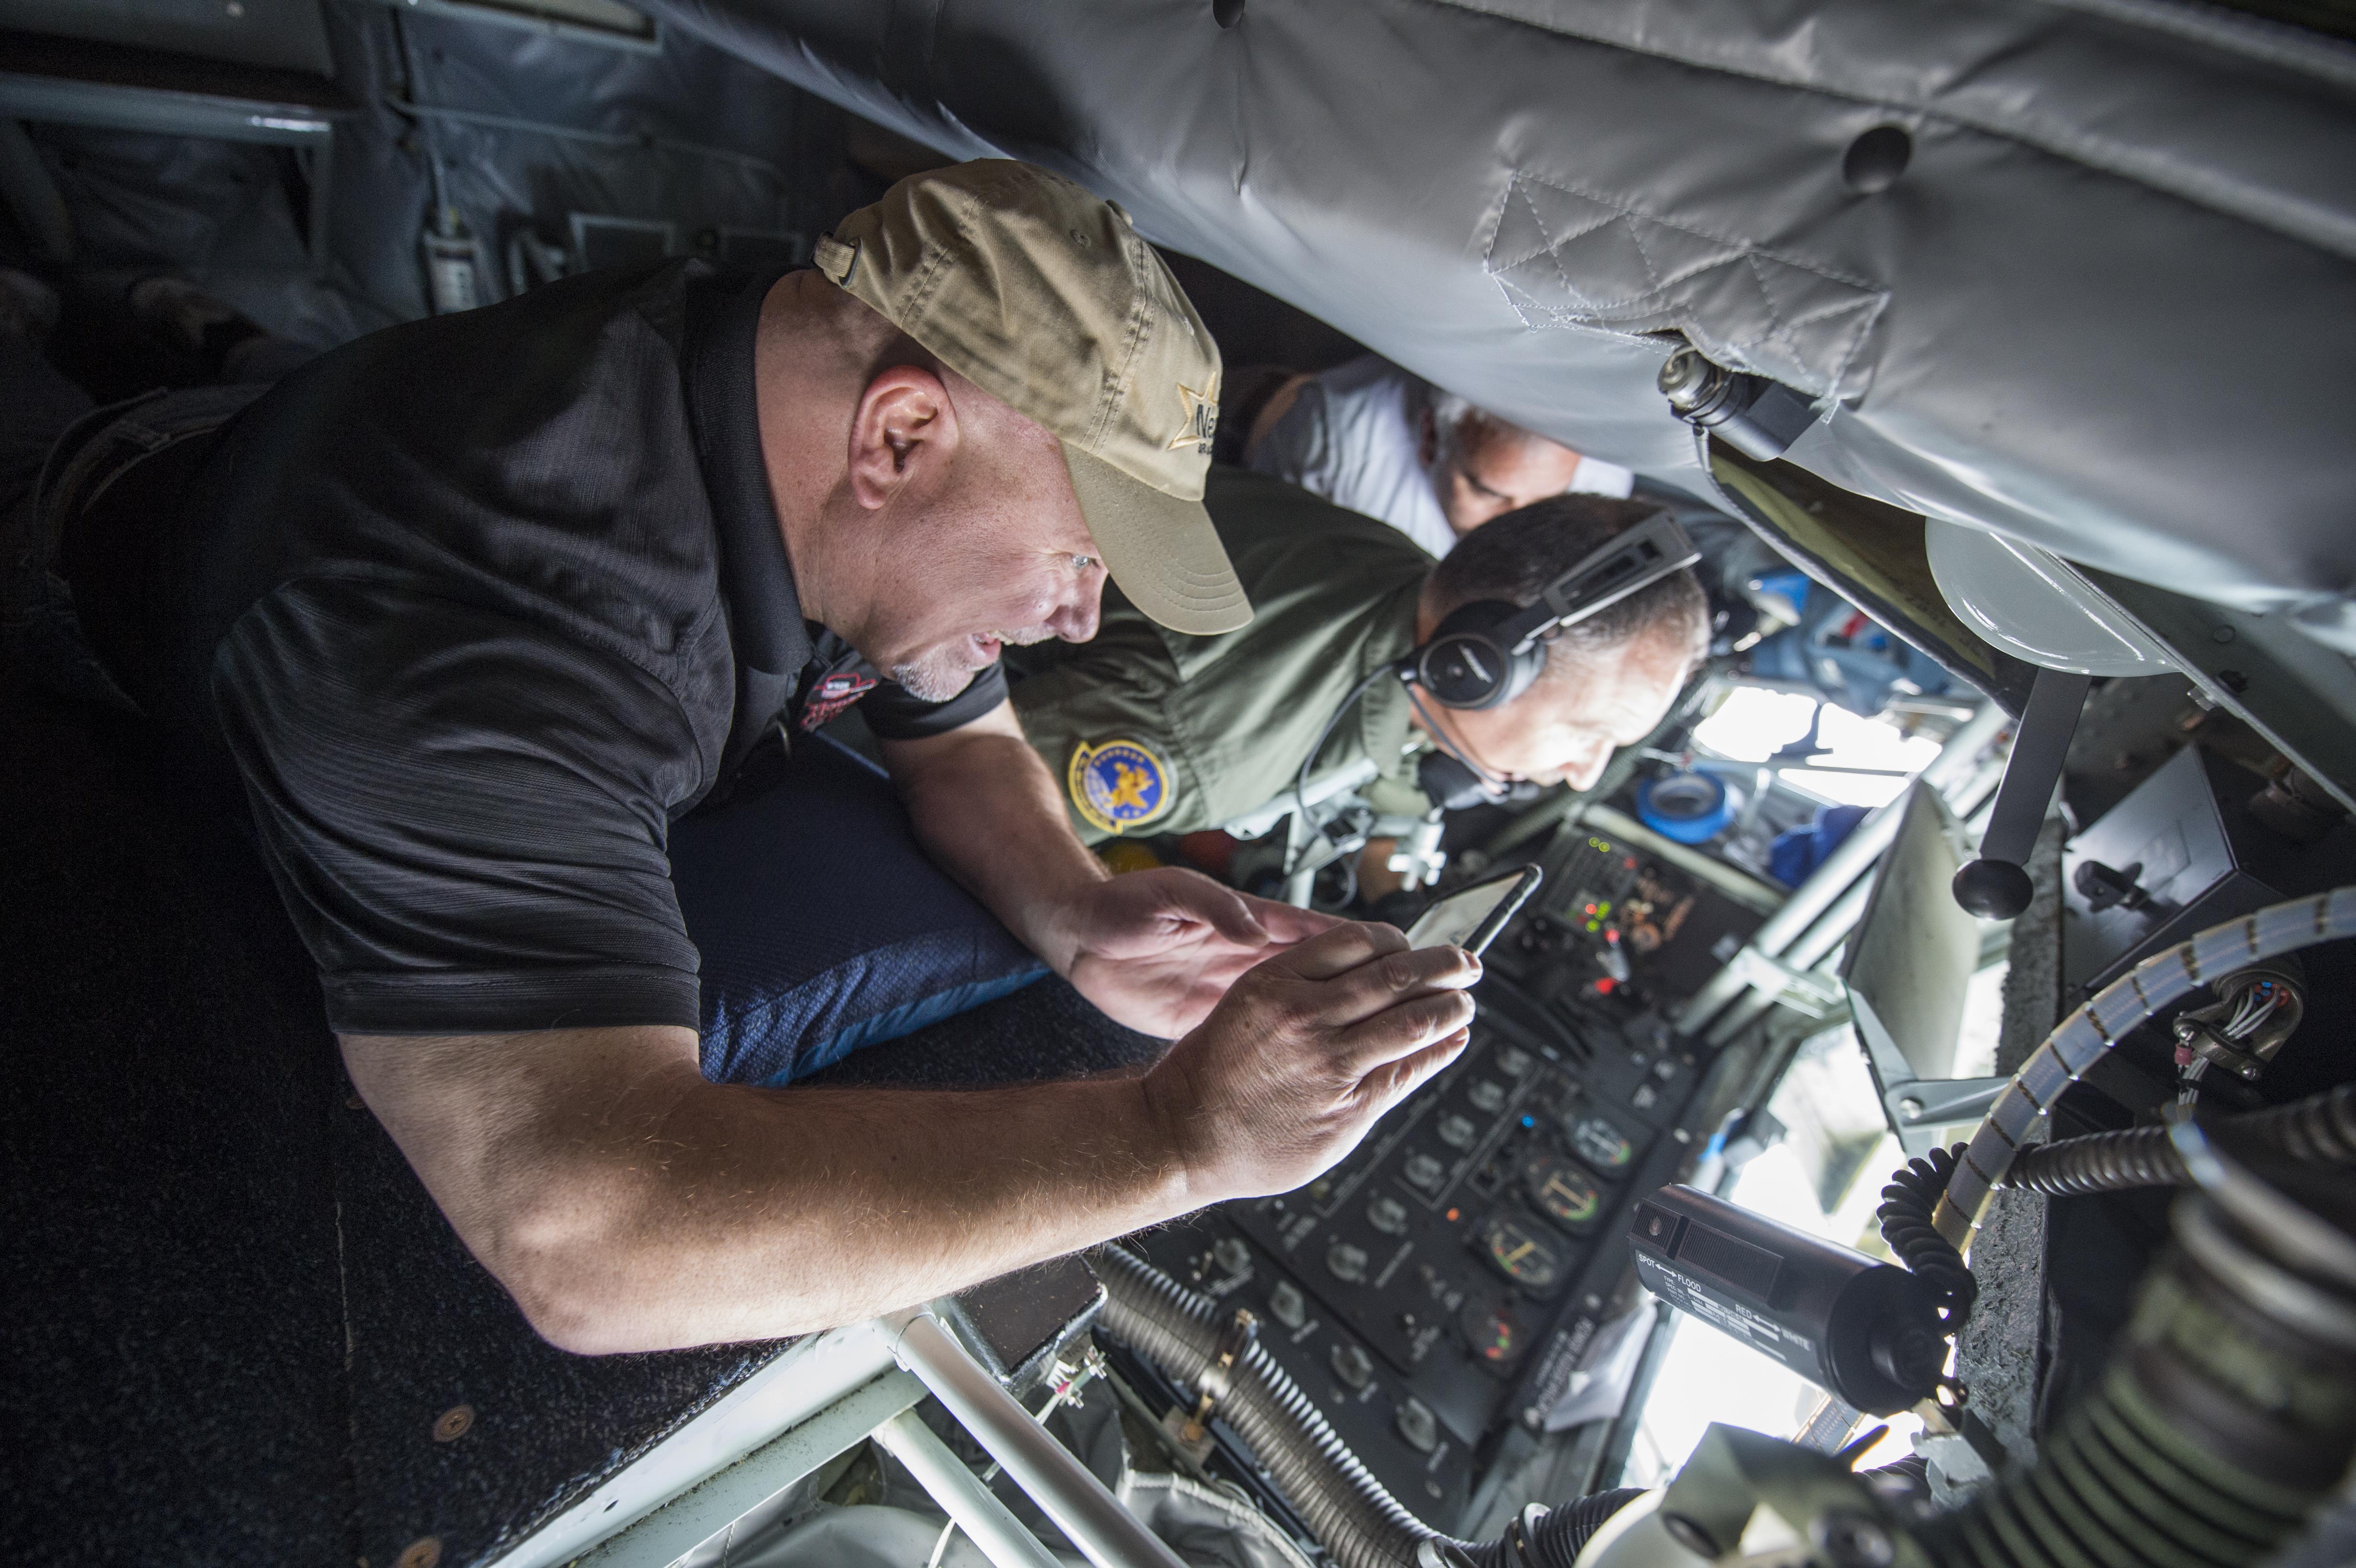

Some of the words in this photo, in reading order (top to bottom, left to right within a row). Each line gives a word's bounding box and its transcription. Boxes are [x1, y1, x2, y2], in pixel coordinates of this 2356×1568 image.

[1639, 1253, 1655, 1268] SPOT
[1678, 1274, 1701, 1292] FLOOD
[1735, 1304, 1752, 1319] RED
[1781, 1327, 1811, 1351] WHITE
